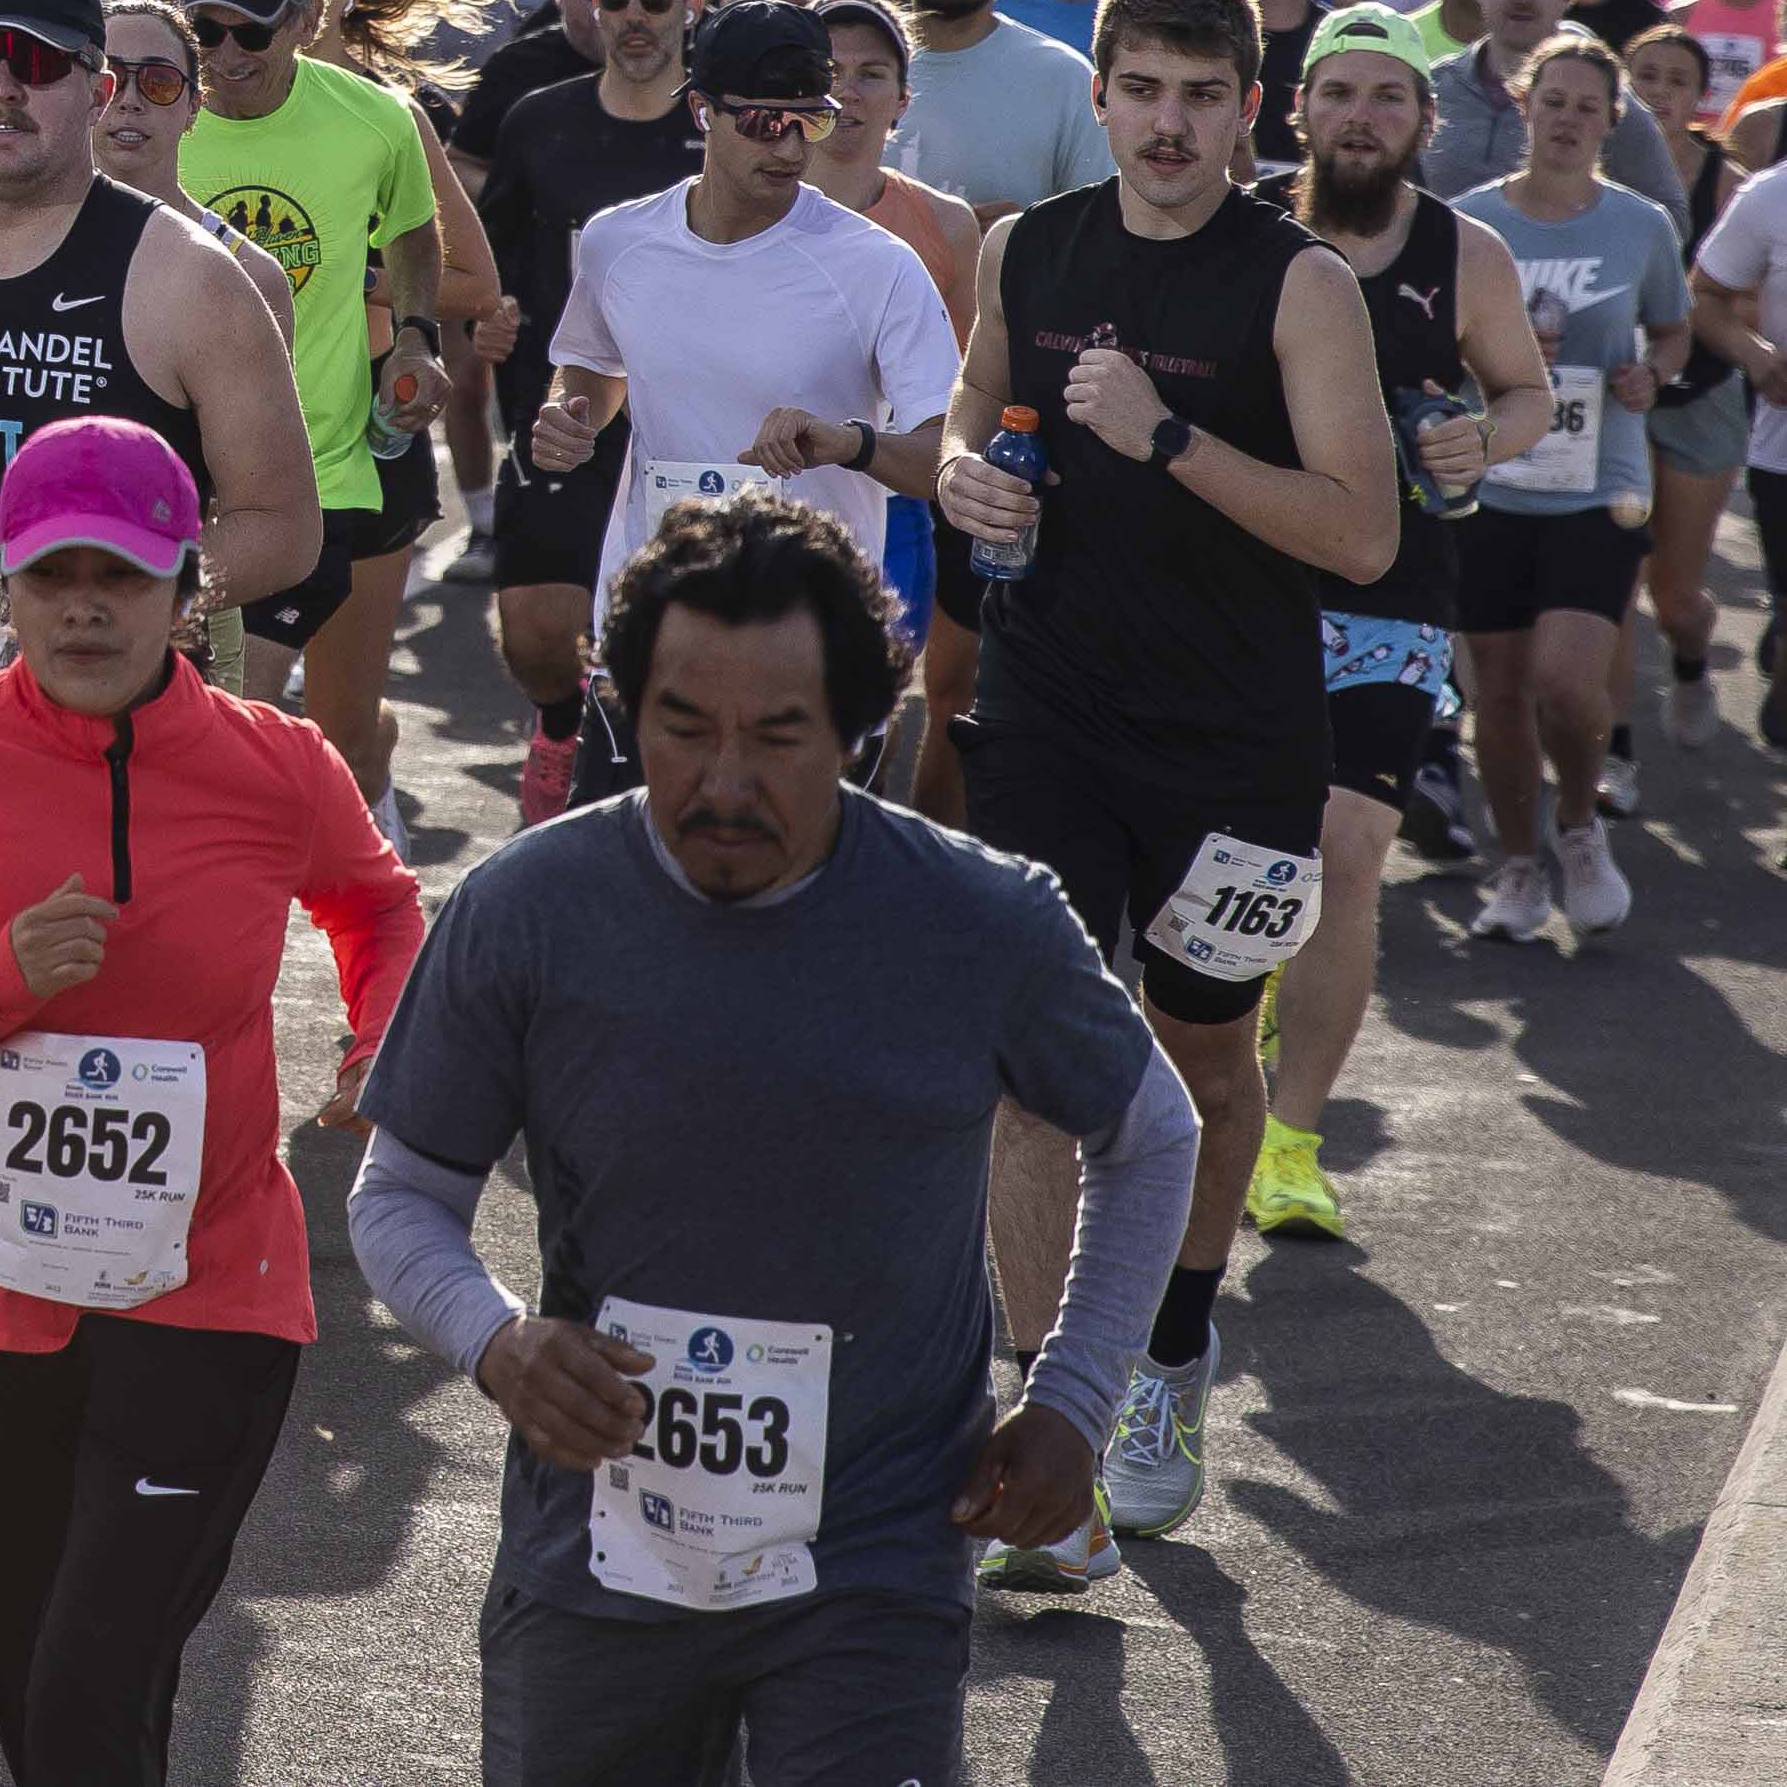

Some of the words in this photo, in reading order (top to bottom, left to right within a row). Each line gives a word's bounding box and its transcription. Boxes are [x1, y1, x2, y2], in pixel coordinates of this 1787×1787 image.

[1204, 885, 1303, 939] 1163
[5, 1100, 172, 1186] 2652
[134, 1188, 156, 1201] 25K
[159, 1190, 186, 1203] RUN
[104, 1216, 144, 1231] THIRD
[752, 1482, 777, 1494] 25K
[779, 1483, 808, 1495] RUN
[721, 1514, 764, 1527] THIRD
